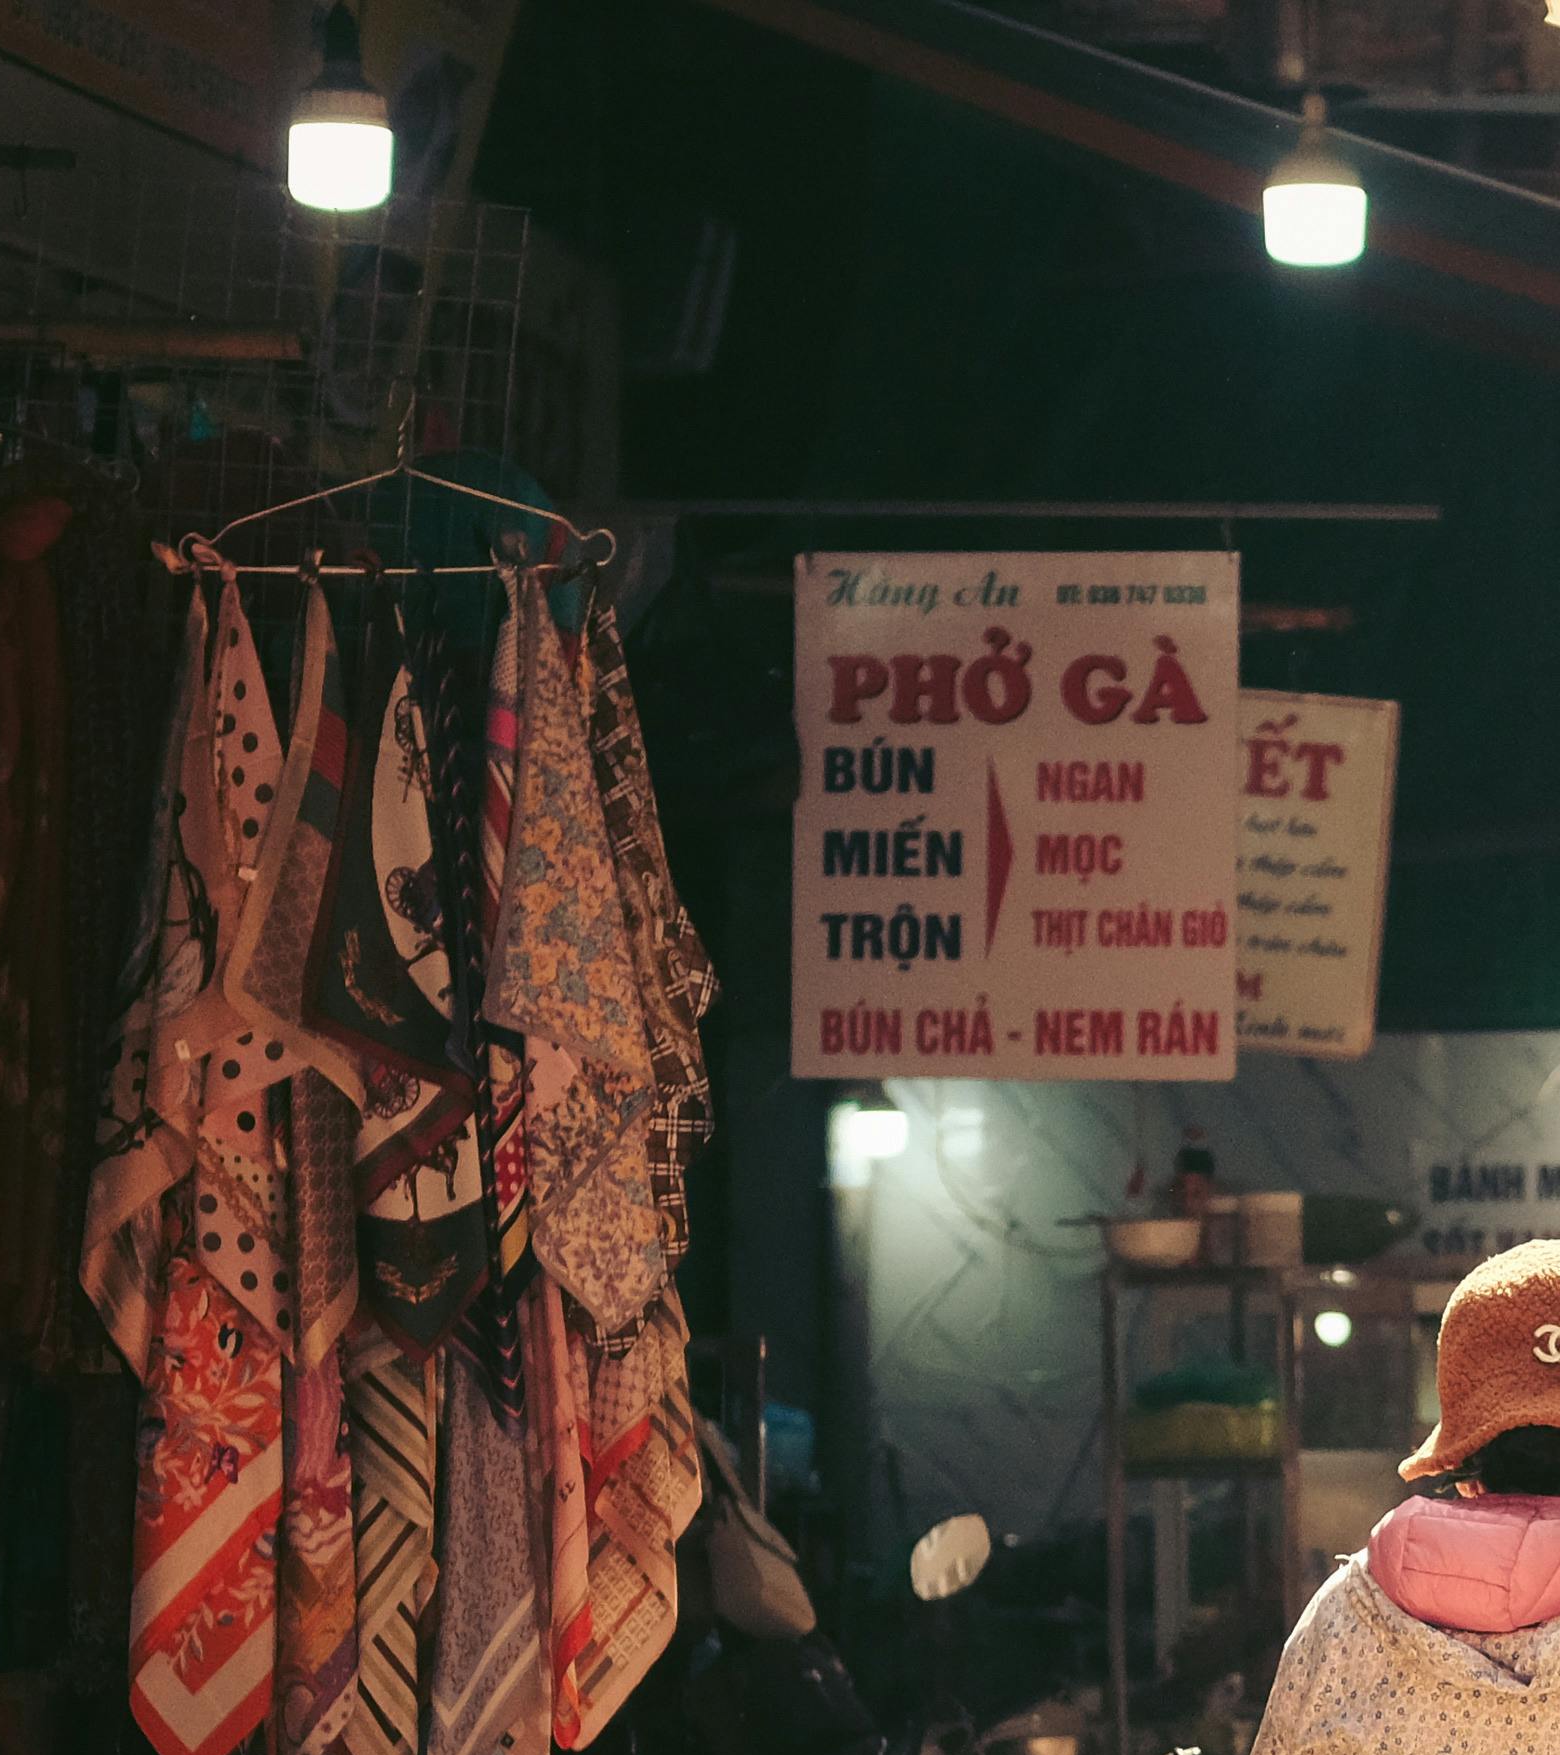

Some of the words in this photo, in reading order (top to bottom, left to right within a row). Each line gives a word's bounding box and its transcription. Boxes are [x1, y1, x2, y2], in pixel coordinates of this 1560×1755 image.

[826, 626, 1032, 725] PHỞ
[1060, 634, 1208, 725] GÀ
[823, 736, 936, 794] BÚN
[1037, 761, 1145, 803] NGAN
[823, 814, 963, 877] MIẾN
[1035, 834, 1122, 884] MỌC
[821, 903, 962, 971] TRỘN
[1032, 909, 1088, 955] THỊT
[821, 998, 902, 1056] BÚN
[916, 992, 994, 1056] CHẢ
[1035, 1008, 1123, 1057] NEM
[1136, 999, 1218, 1056] RÁN
